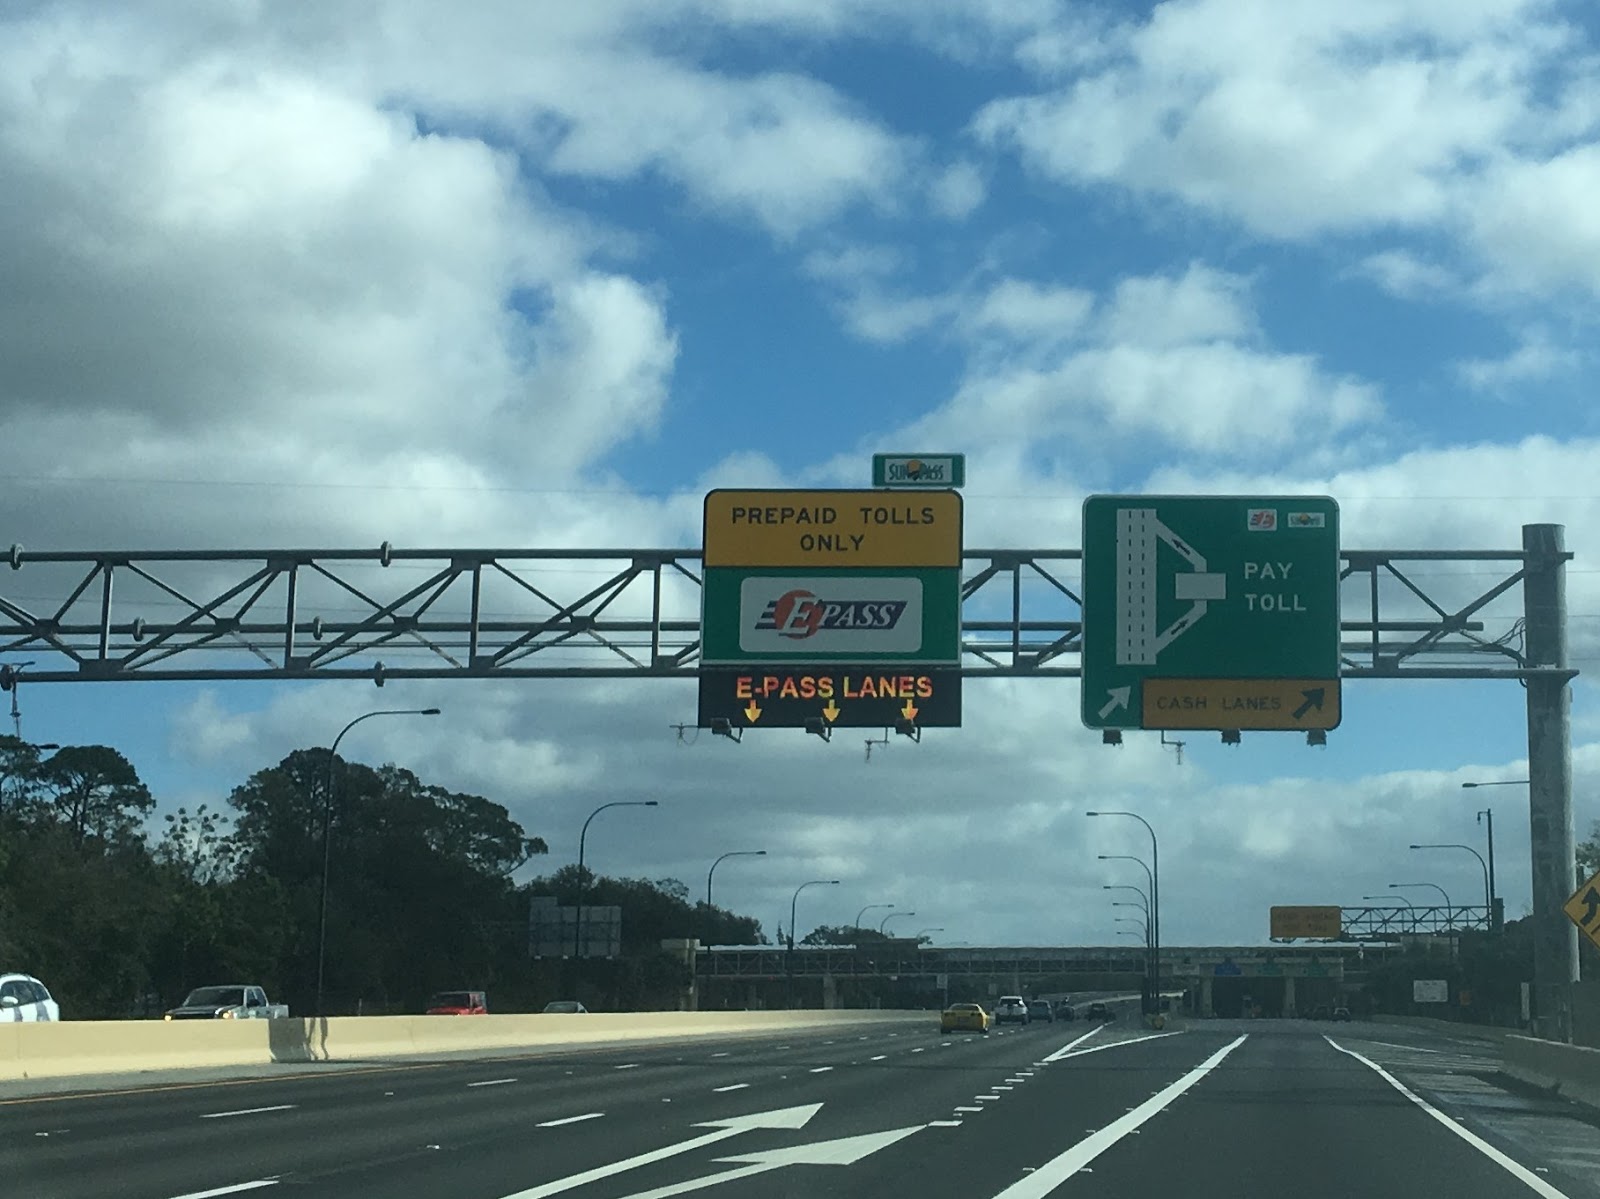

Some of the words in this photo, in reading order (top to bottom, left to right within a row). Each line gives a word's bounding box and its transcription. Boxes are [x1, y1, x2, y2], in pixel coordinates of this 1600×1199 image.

[732, 507, 837, 524] PREPAID
[860, 507, 935, 524] TOLLS
[800, 534, 865, 551] ONLY
[1244, 562, 1293, 580] PAY
[1245, 594, 1307, 611] TOLL
[736, 676, 834, 698] E-PASS
[843, 676, 933, 698] LANES
[1157, 696, 1208, 710] CASH
[1222, 696, 1282, 711] LANES
